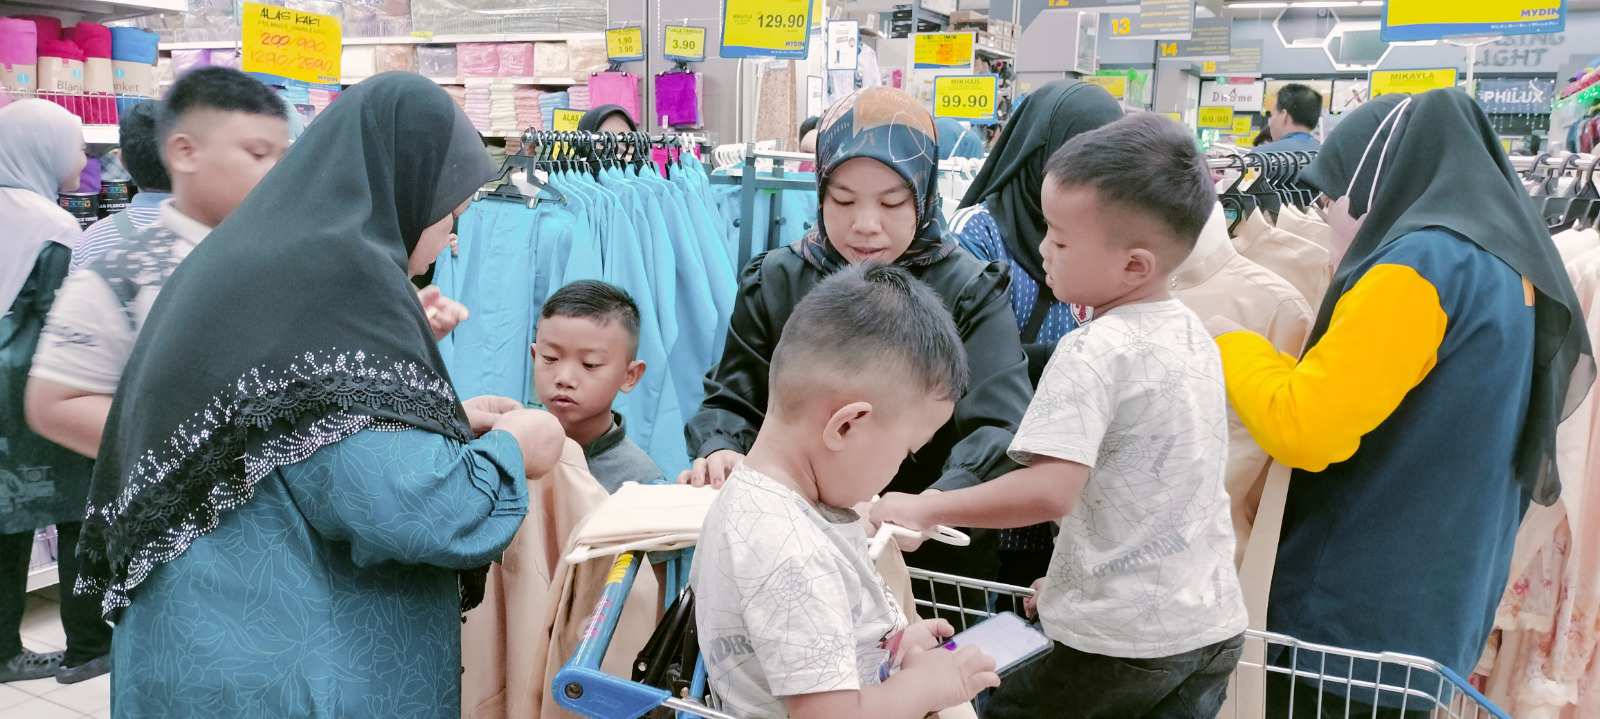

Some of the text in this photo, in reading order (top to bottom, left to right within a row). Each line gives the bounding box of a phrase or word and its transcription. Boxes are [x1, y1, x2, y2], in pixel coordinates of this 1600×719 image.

[260, 8, 320, 26] ALAS KAKI
[1521, 8, 1559, 17] MYDIN
[757, 14, 805, 28] 129.90
[1112, 18, 1131, 35] 13
[672, 39, 695, 50] 3.90
[1161, 42, 1178, 57] 14
[1203, 61, 1217, 73] 15
[1390, 72, 1435, 81] MIKAYLA
[942, 95, 988, 108] 99.90
[1484, 89, 1544, 103] PHILUX
[1092, 531, 1190, 578] SPIDER-MAN
